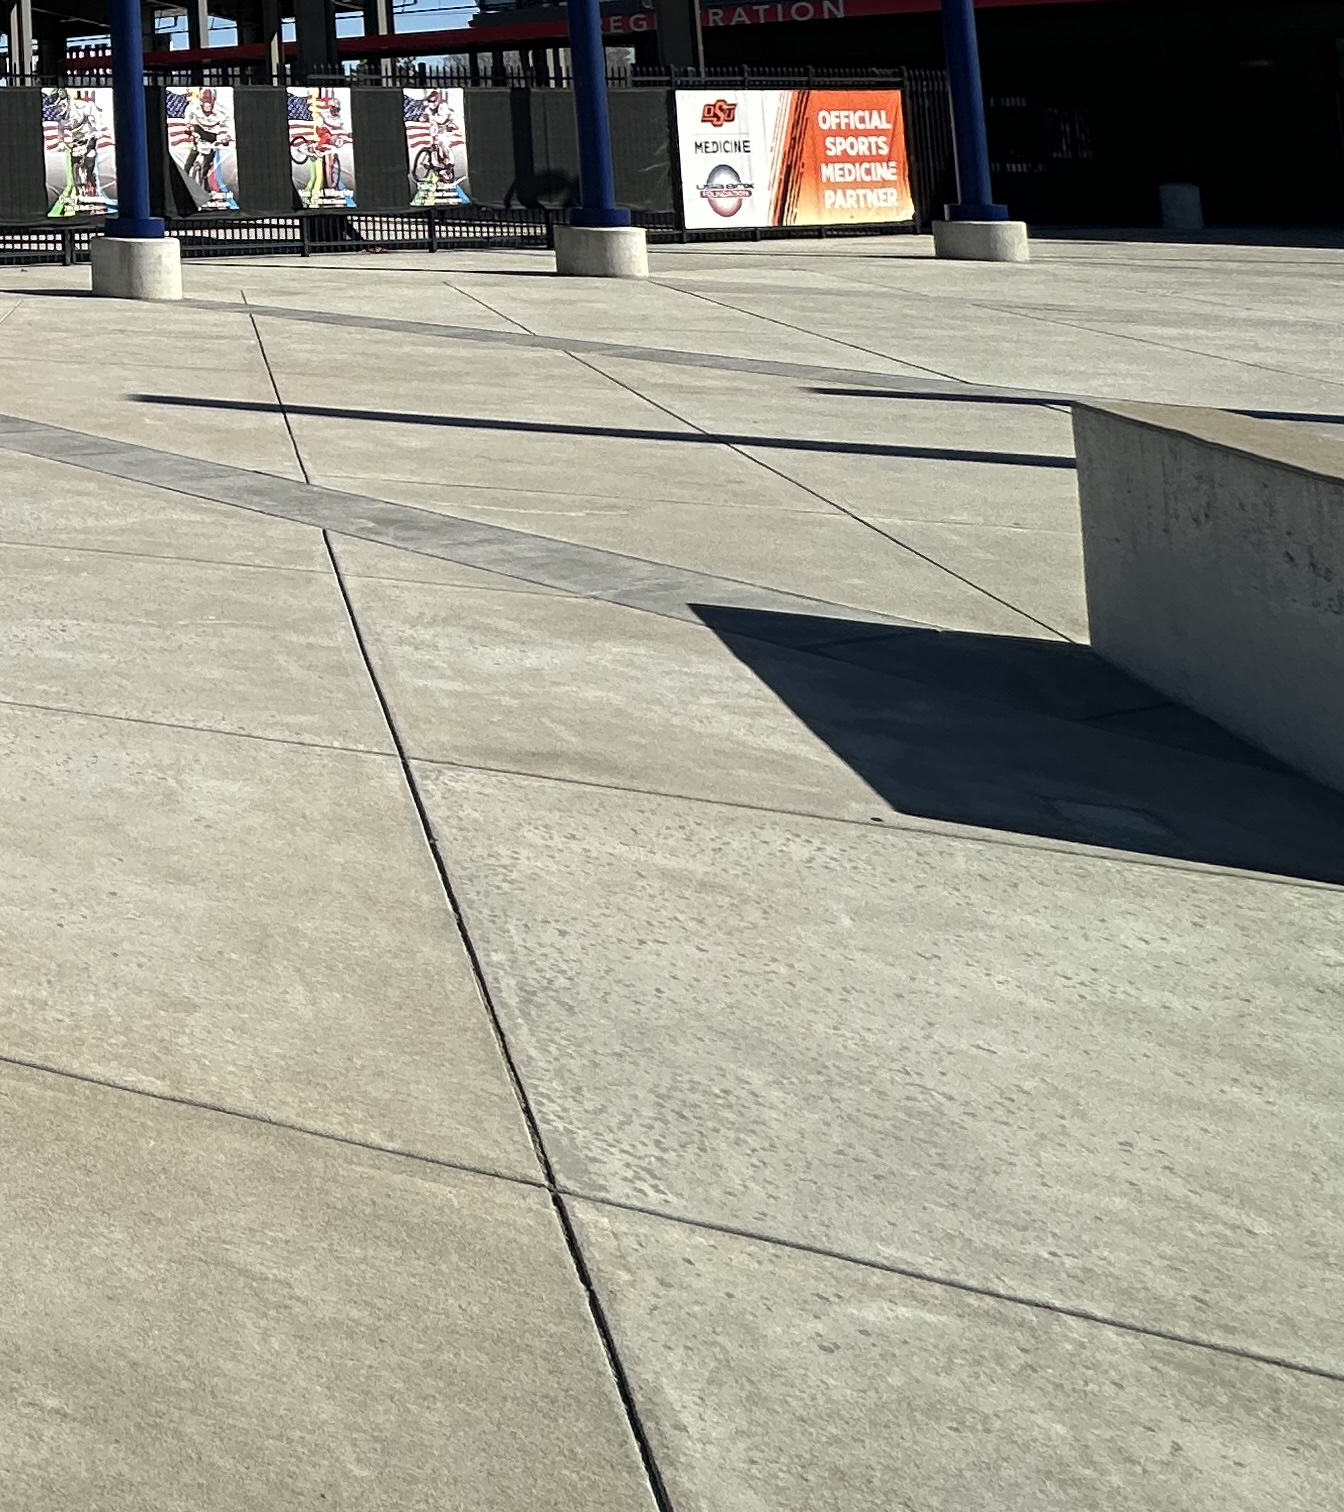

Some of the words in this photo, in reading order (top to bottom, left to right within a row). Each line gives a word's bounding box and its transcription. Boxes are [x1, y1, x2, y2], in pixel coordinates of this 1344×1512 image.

[818, 110, 892, 130] OFFICIAL
[694, 140, 751, 154] MEDICINE
[825, 136, 889, 156] SPORTS
[820, 161, 898, 183] MEDICINE
[824, 188, 899, 209] PARTNER
